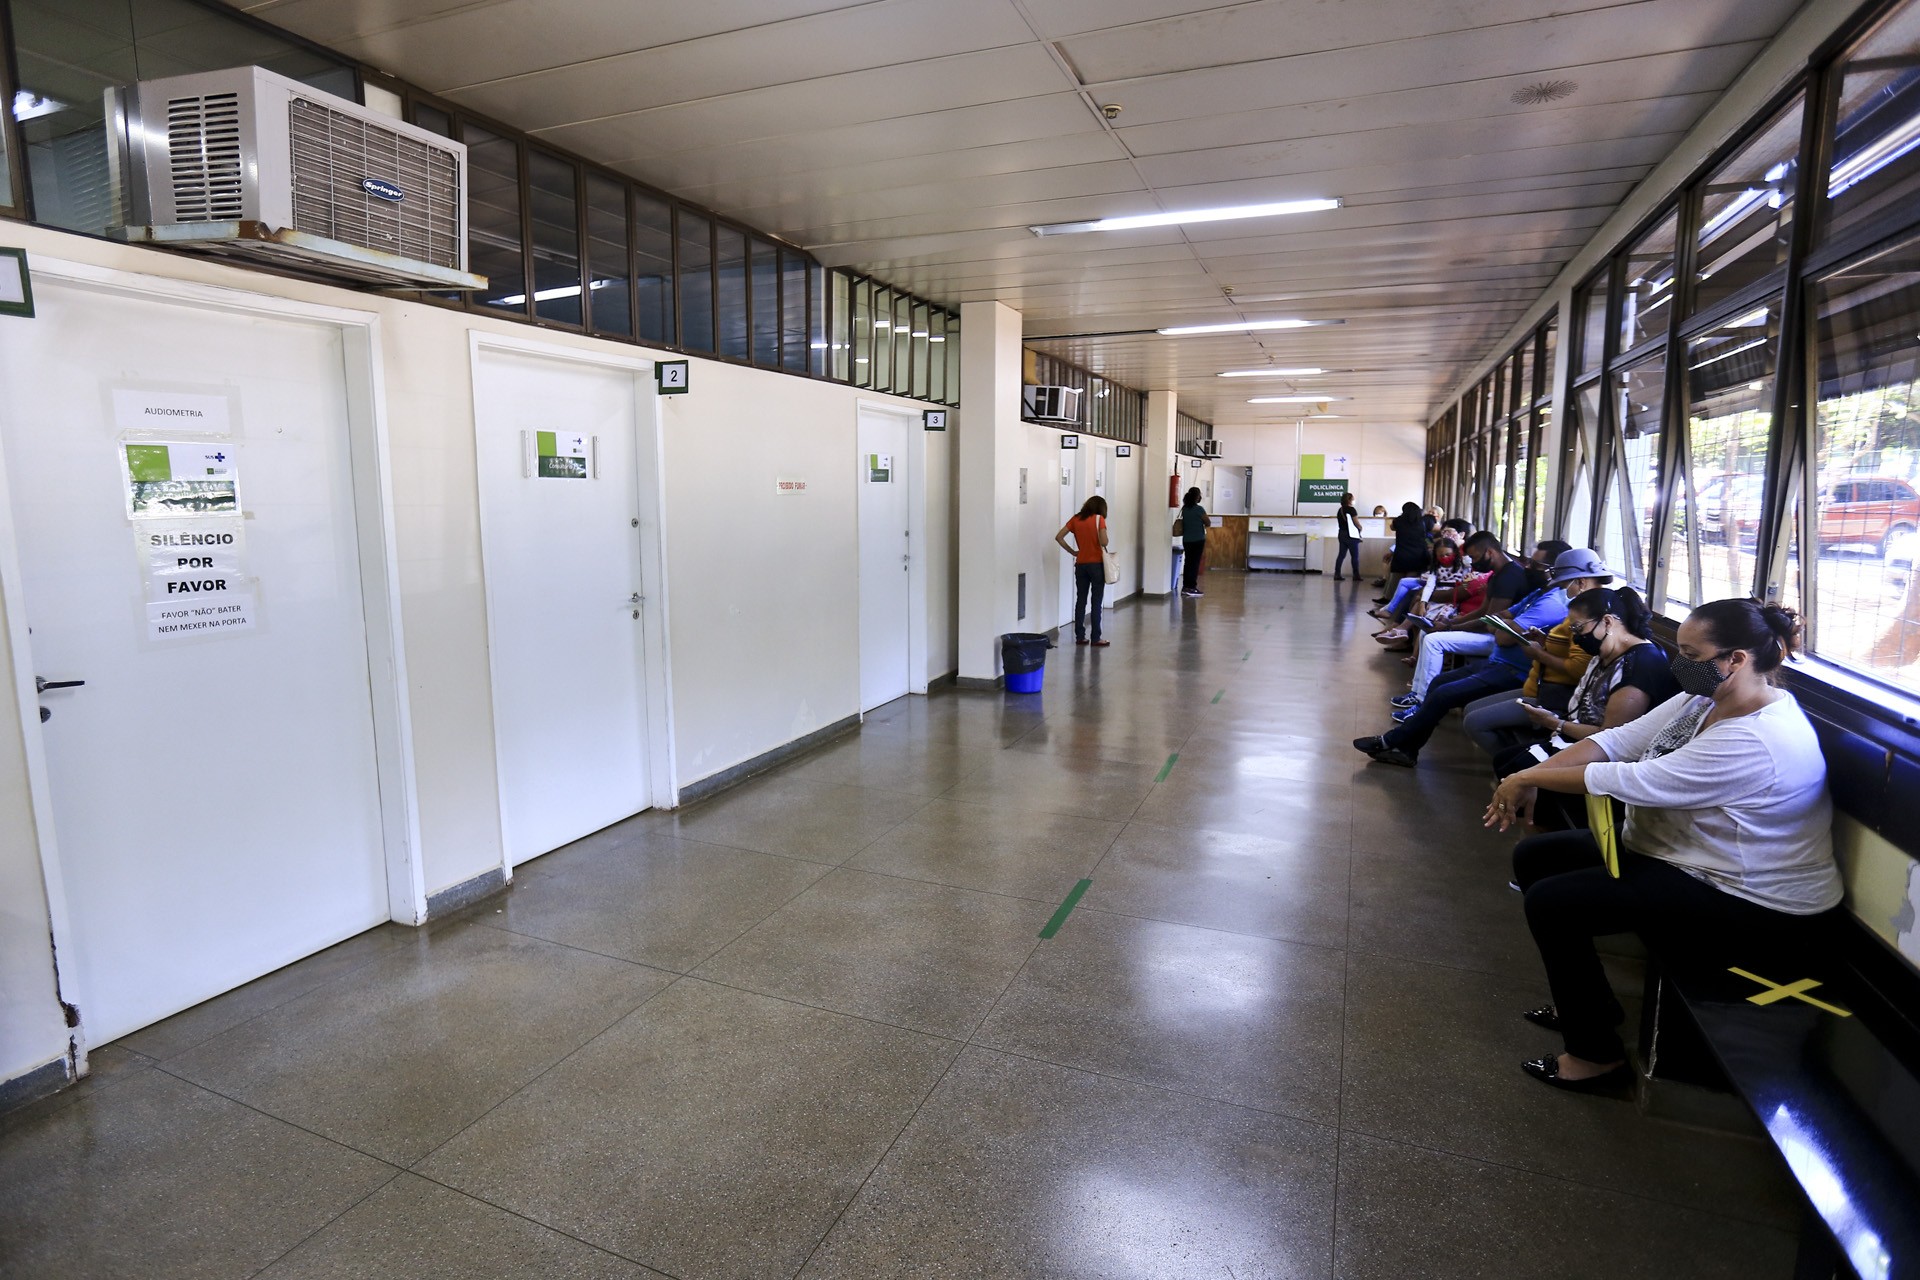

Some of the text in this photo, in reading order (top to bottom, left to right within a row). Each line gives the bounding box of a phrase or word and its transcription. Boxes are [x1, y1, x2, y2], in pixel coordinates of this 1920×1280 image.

[365, 181, 402, 197] Springer
[670, 369, 678, 382] 2
[144, 407, 203, 418] AUDIOMETRIA
[932, 415, 939, 424] 3
[151, 531, 234, 547] SILÊNCIO
[177, 557, 213, 569] POR
[167, 580, 227, 594] FAVOR
[161, 610, 189, 619] FAVOR
[217, 605, 242, 614] BATER
[158, 617, 247, 634] NEM MEXER NA PORTA
